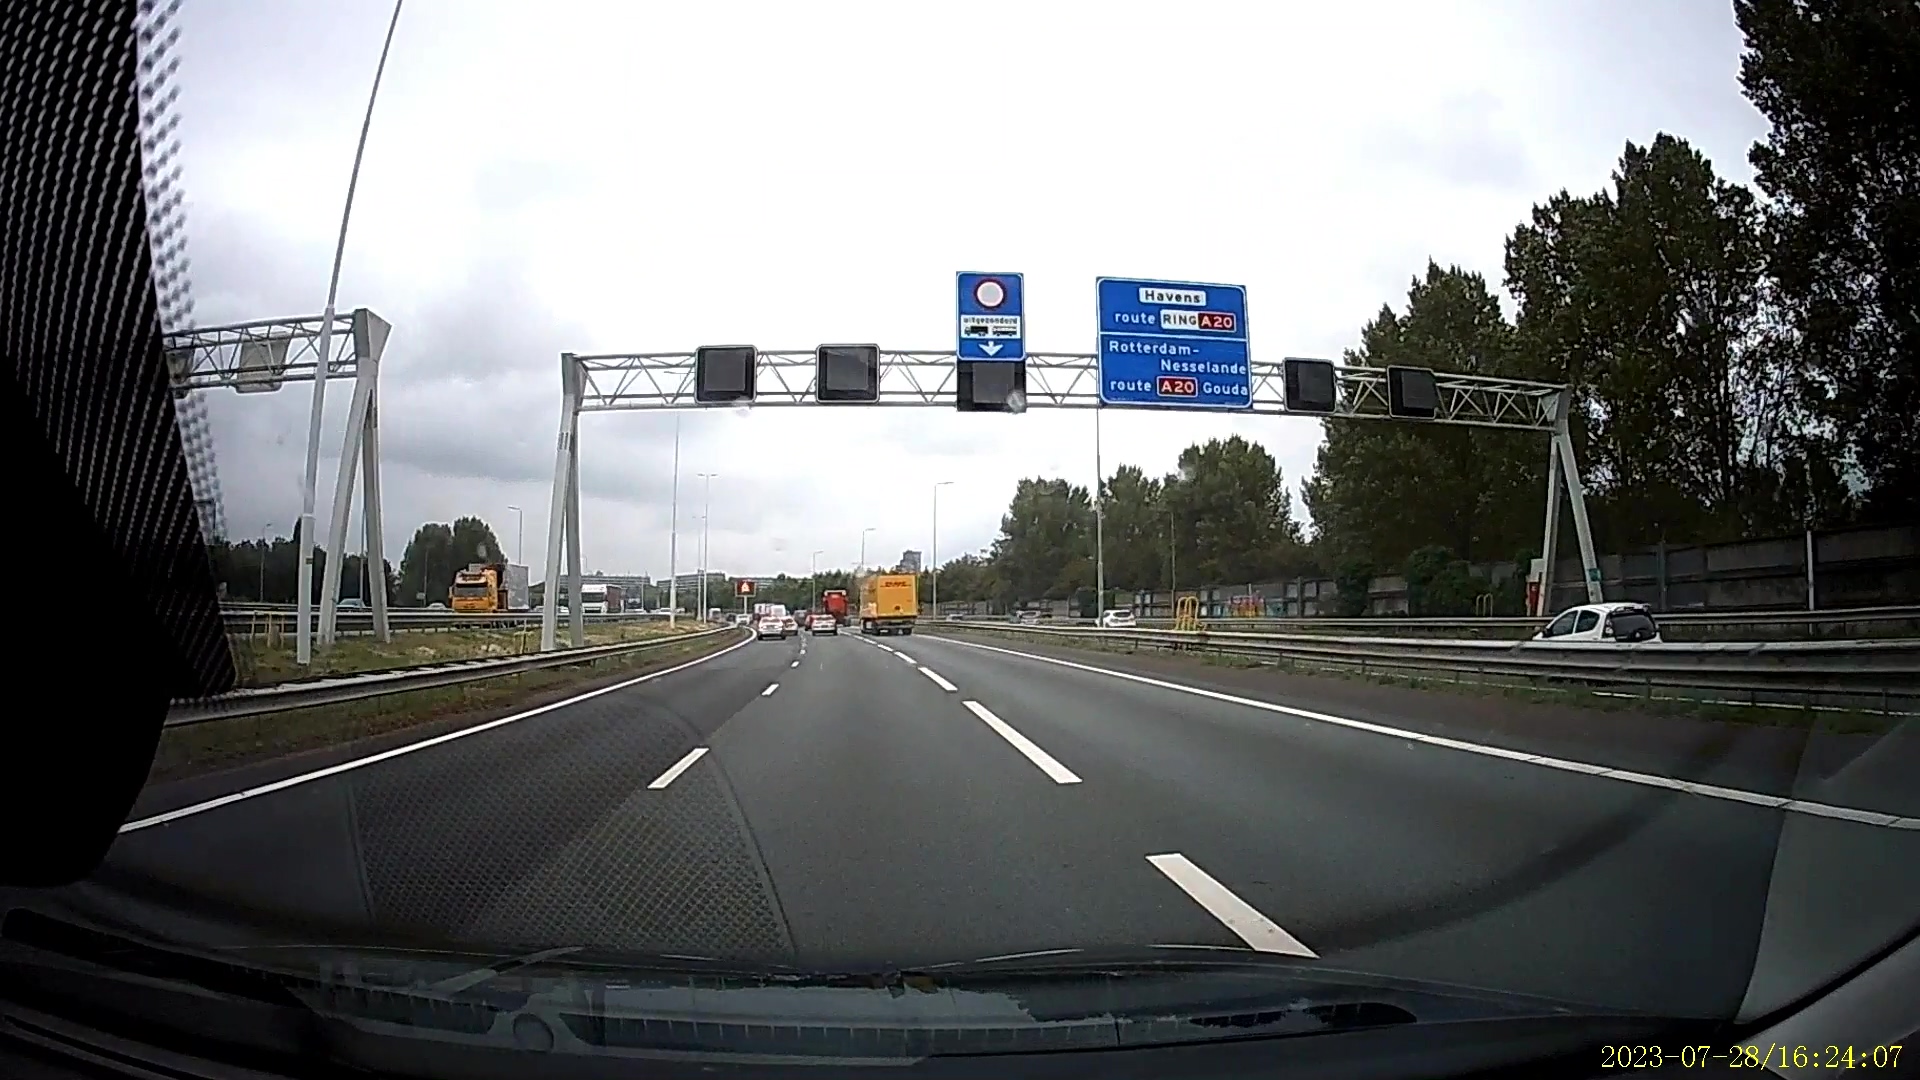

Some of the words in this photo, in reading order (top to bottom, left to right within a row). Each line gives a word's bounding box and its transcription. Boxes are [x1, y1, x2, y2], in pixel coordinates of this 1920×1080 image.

[1145, 290, 1201, 304] Havens
[1115, 312, 1156, 324] route
[1163, 313, 1197, 326] RING
[1201, 316, 1233, 328] A20
[1109, 340, 1200, 355] Rotterdam-
[1160, 359, 1247, 375] Nesselande
[1110, 380, 1152, 392] route
[1161, 380, 1194, 393] A20
[1202, 382, 1249, 395] Gouda
